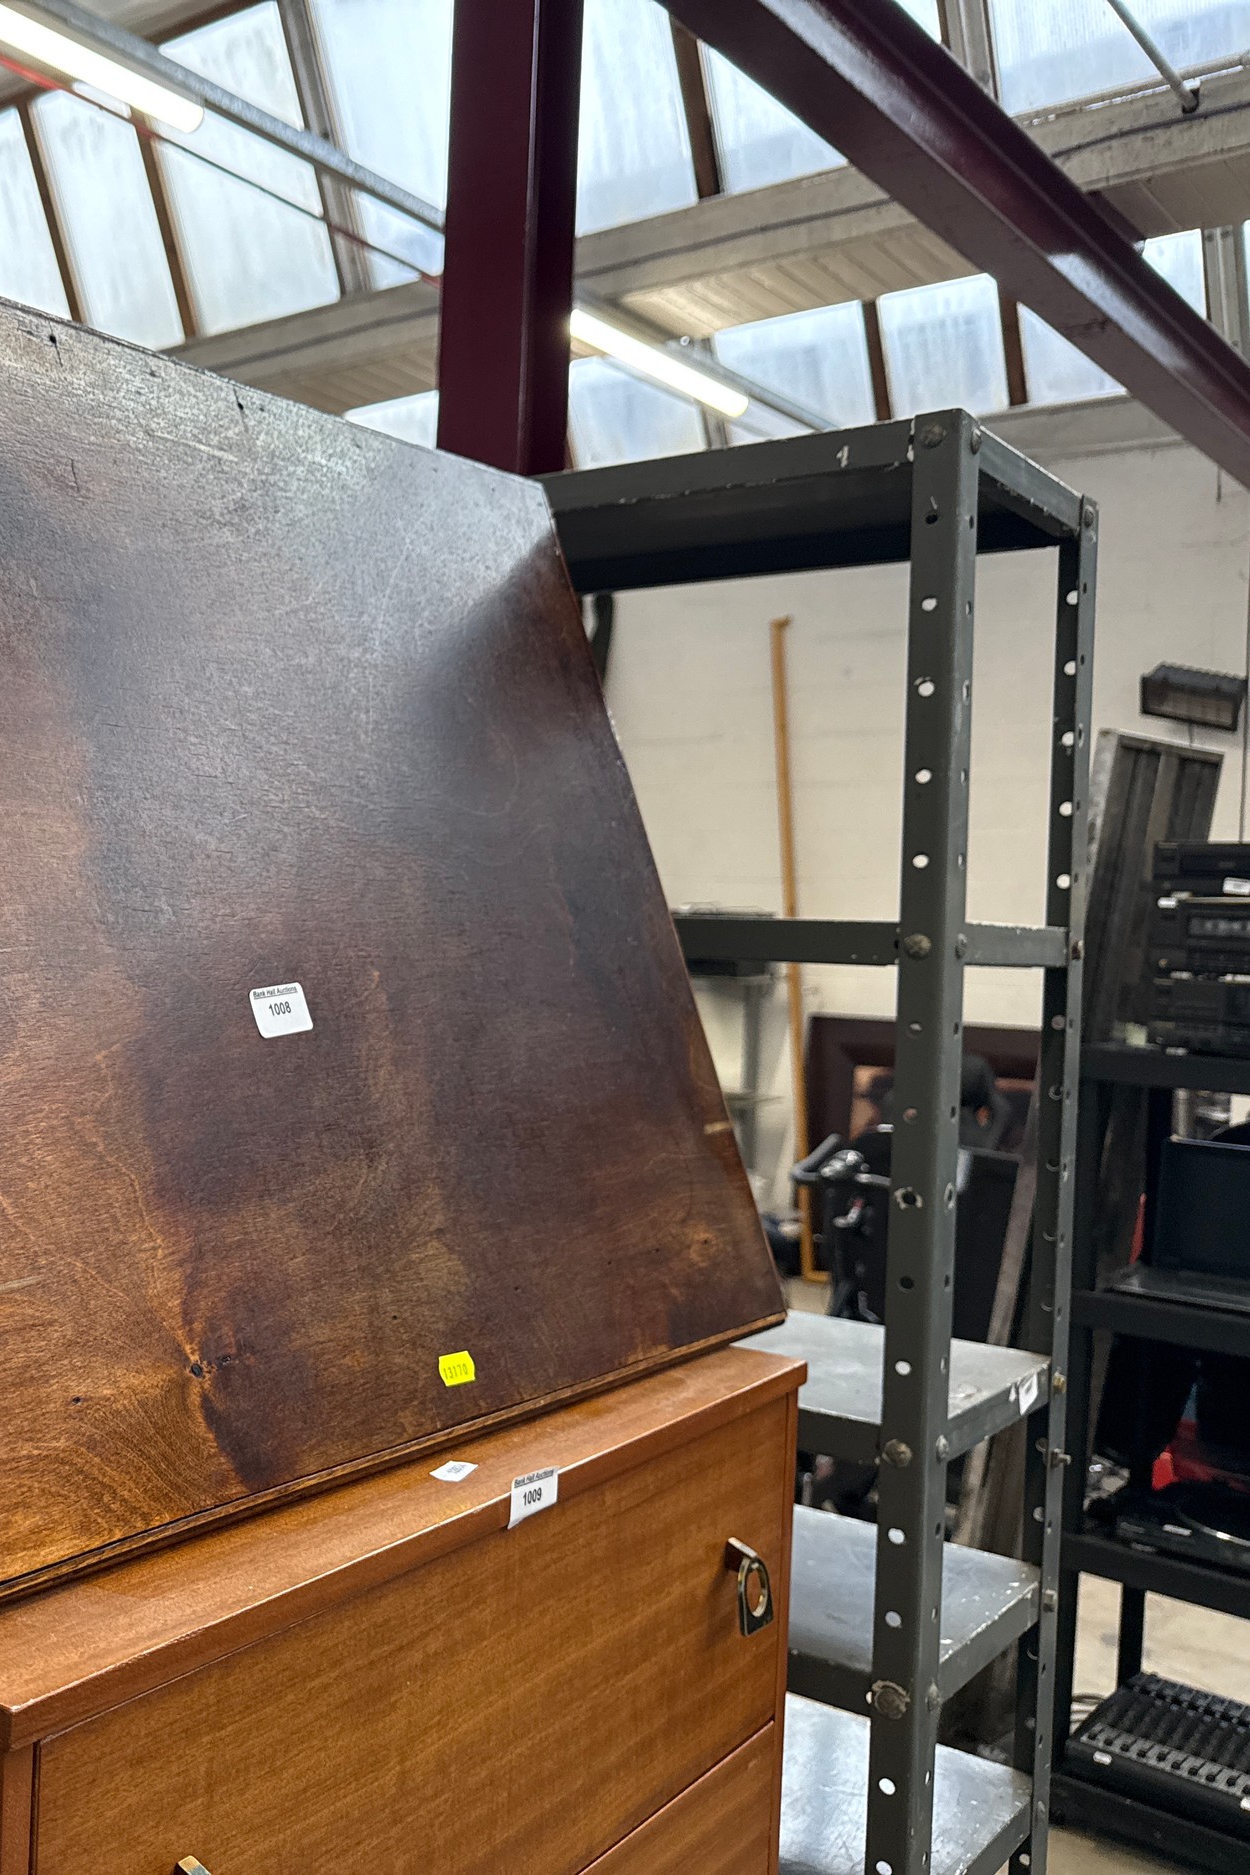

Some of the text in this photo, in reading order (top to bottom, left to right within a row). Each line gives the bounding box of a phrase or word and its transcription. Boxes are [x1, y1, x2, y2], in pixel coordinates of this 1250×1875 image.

[268, 1001, 292, 1017] 1008
[443, 1363, 469, 1380] 13170
[522, 1487, 542, 1506] 1009
